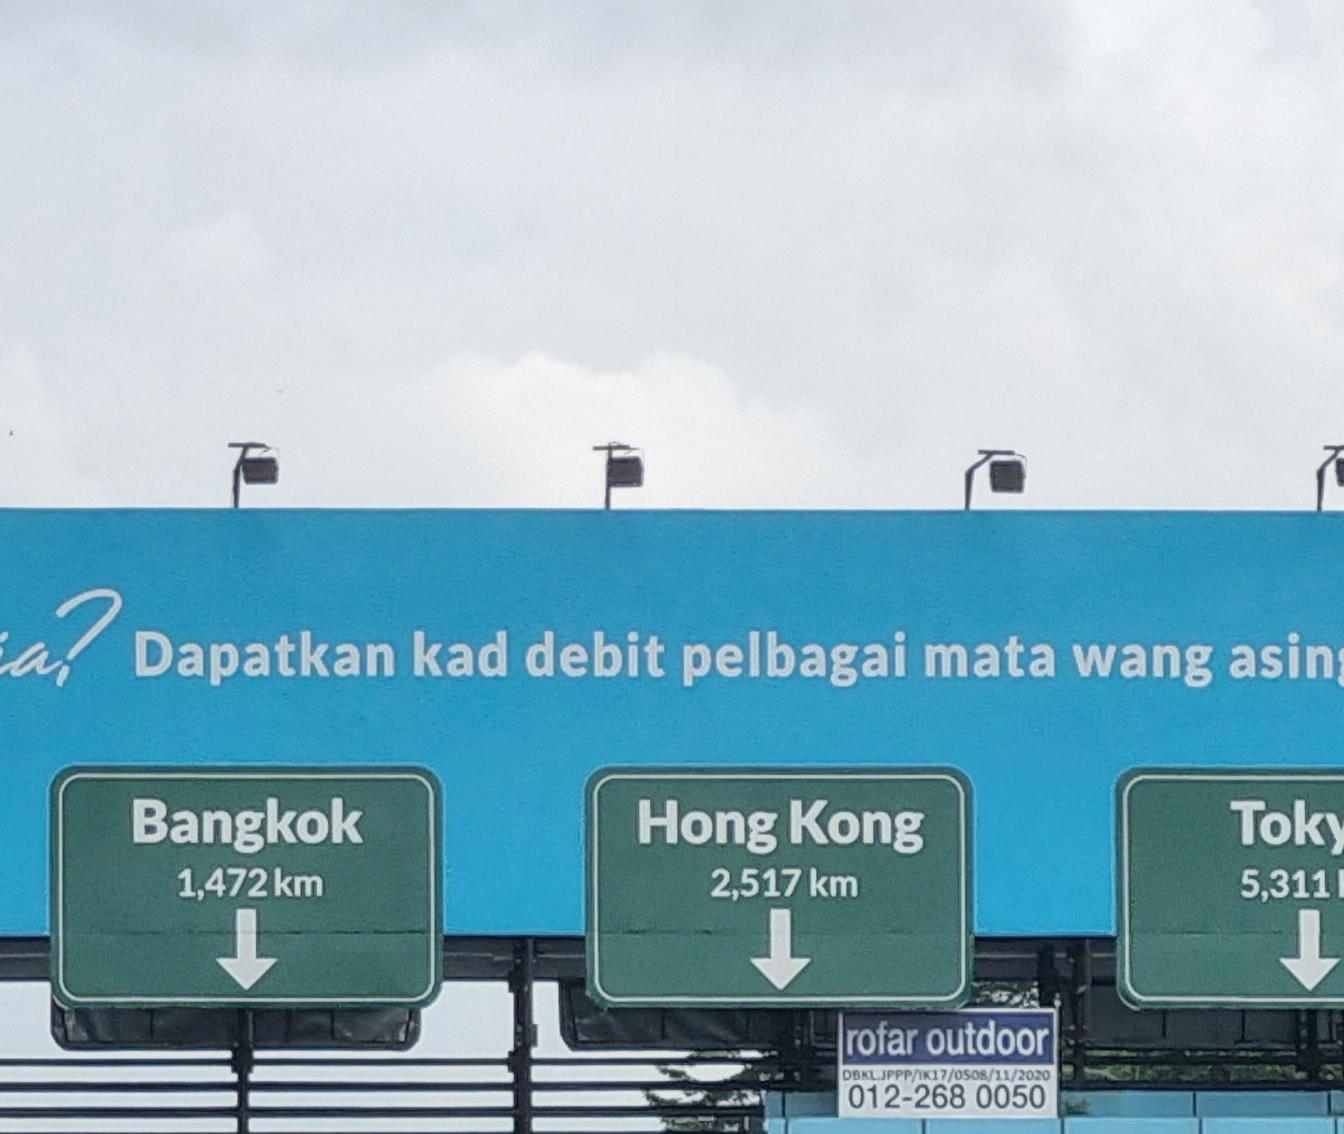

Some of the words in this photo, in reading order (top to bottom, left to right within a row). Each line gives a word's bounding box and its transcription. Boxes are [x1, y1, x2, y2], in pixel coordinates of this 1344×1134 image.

[134, 629, 395, 686] Dapatkan
[413, 629, 508, 678] kad
[525, 629, 666, 679] debit
[683, 629, 907, 688] pelbagai
[923, 634, 1056, 679] mata
[1072, 642, 1213, 688] wang
[131, 796, 364, 855] Bangkok
[637, 798, 778, 855] Hong
[789, 798, 926, 855] Kong
[177, 866, 269, 902] 1,472
[273, 866, 324, 898] km
[709, 867, 803, 902] 2,517
[809, 866, 859, 898] km
[1240, 867, 1331, 903] 5,311
[846, 1021, 919, 1056] rofar
[926, 1019, 1050, 1057] outdoor
[848, 1083, 966, 1109] 012-268
[975, 1083, 1046, 1109] 0050
